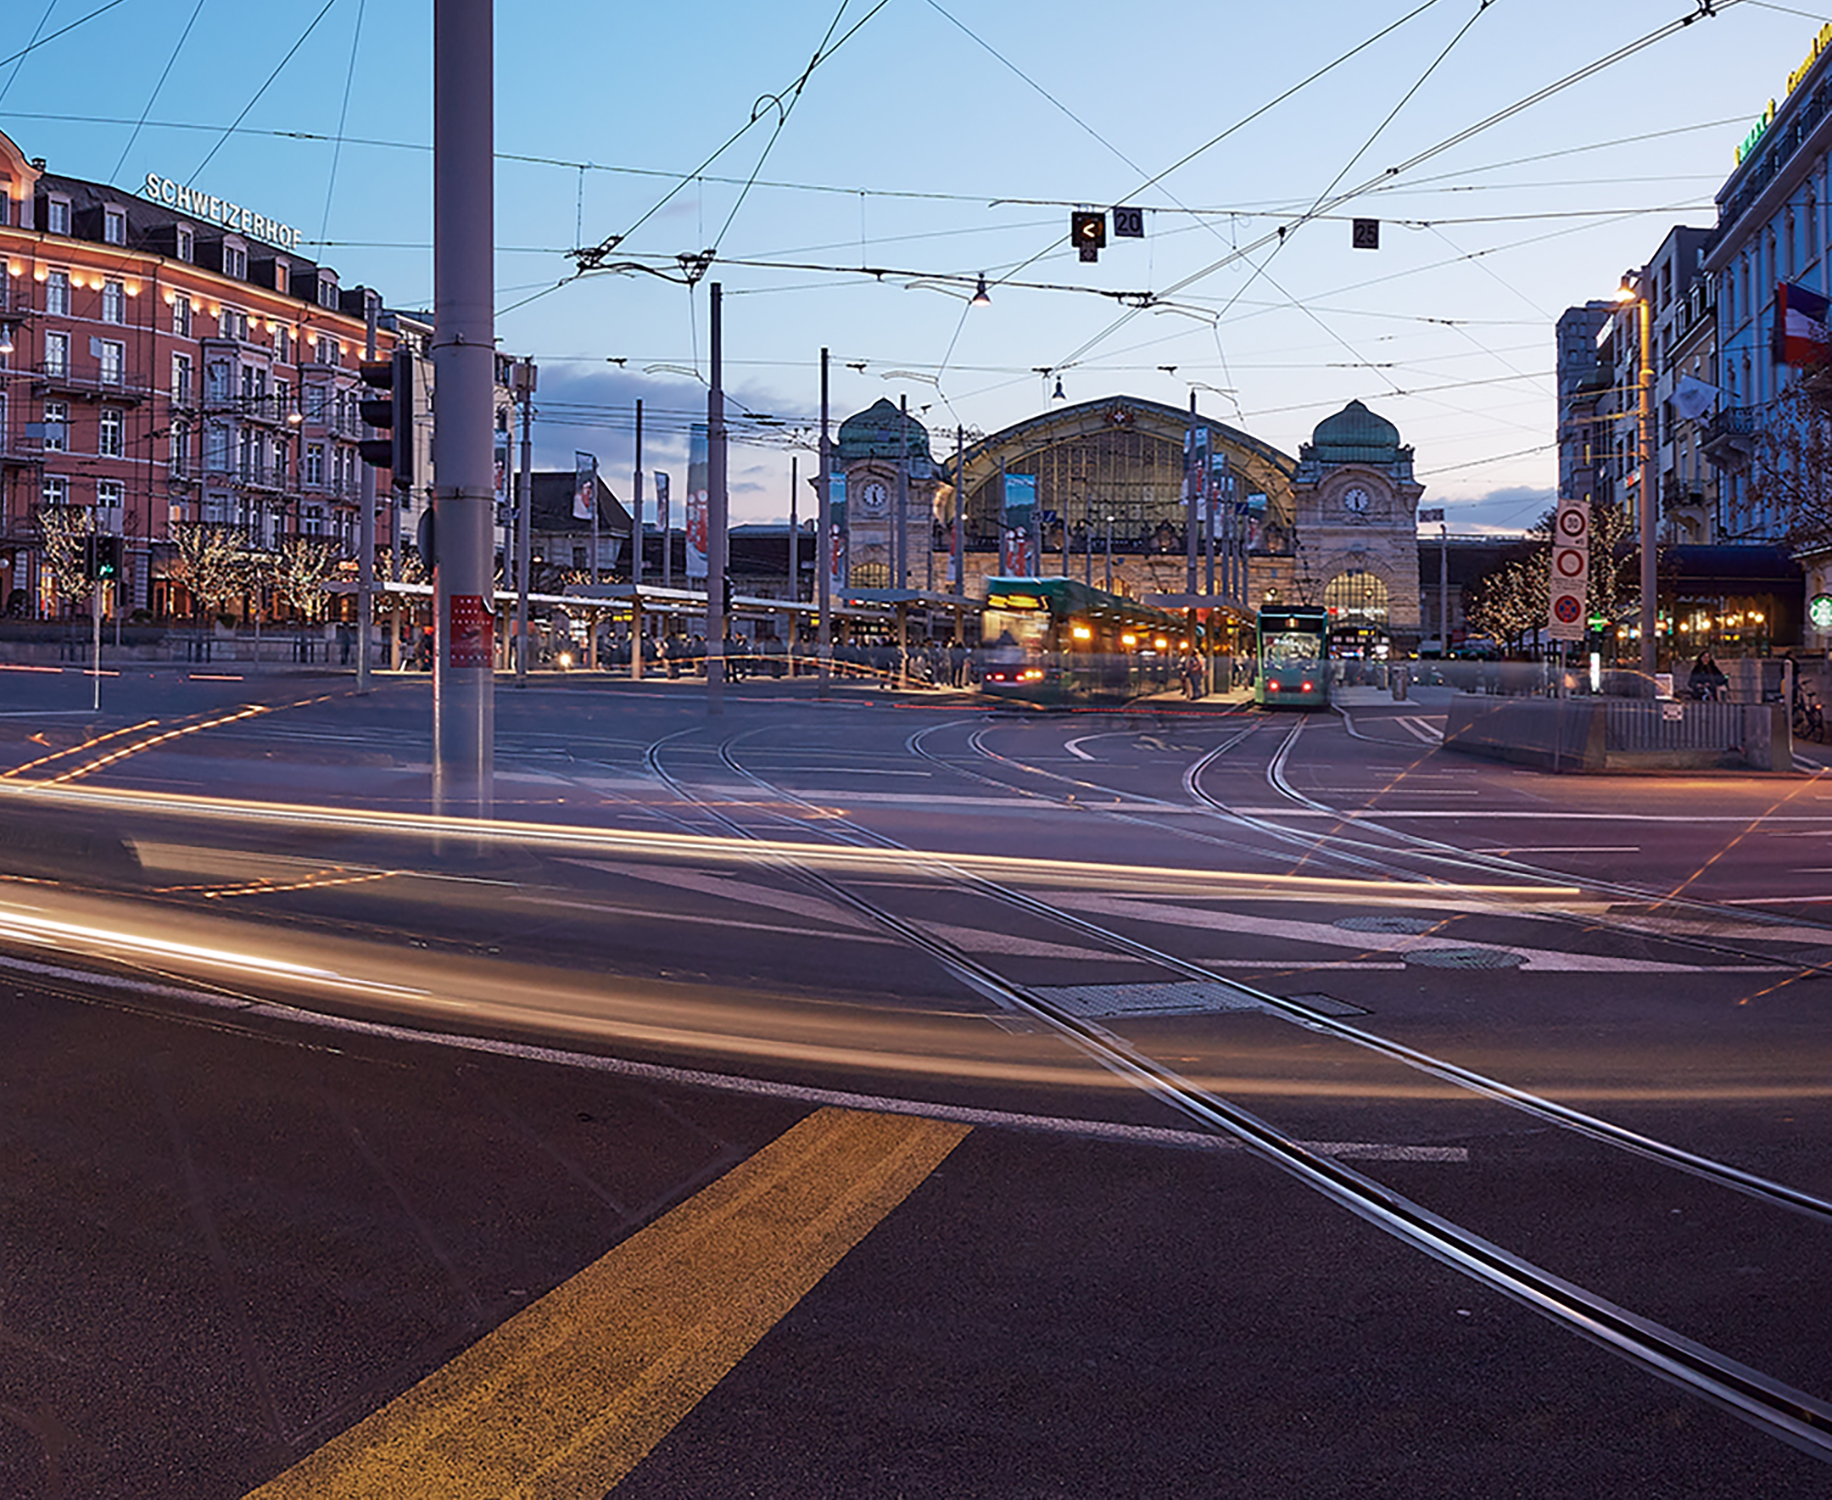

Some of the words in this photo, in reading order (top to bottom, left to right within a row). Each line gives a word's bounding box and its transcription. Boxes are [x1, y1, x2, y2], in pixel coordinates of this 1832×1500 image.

[146, 172, 303, 250] SCHWEIZERHOF
[1116, 212, 1141, 232] 20
[1356, 224, 1376, 244] 25
